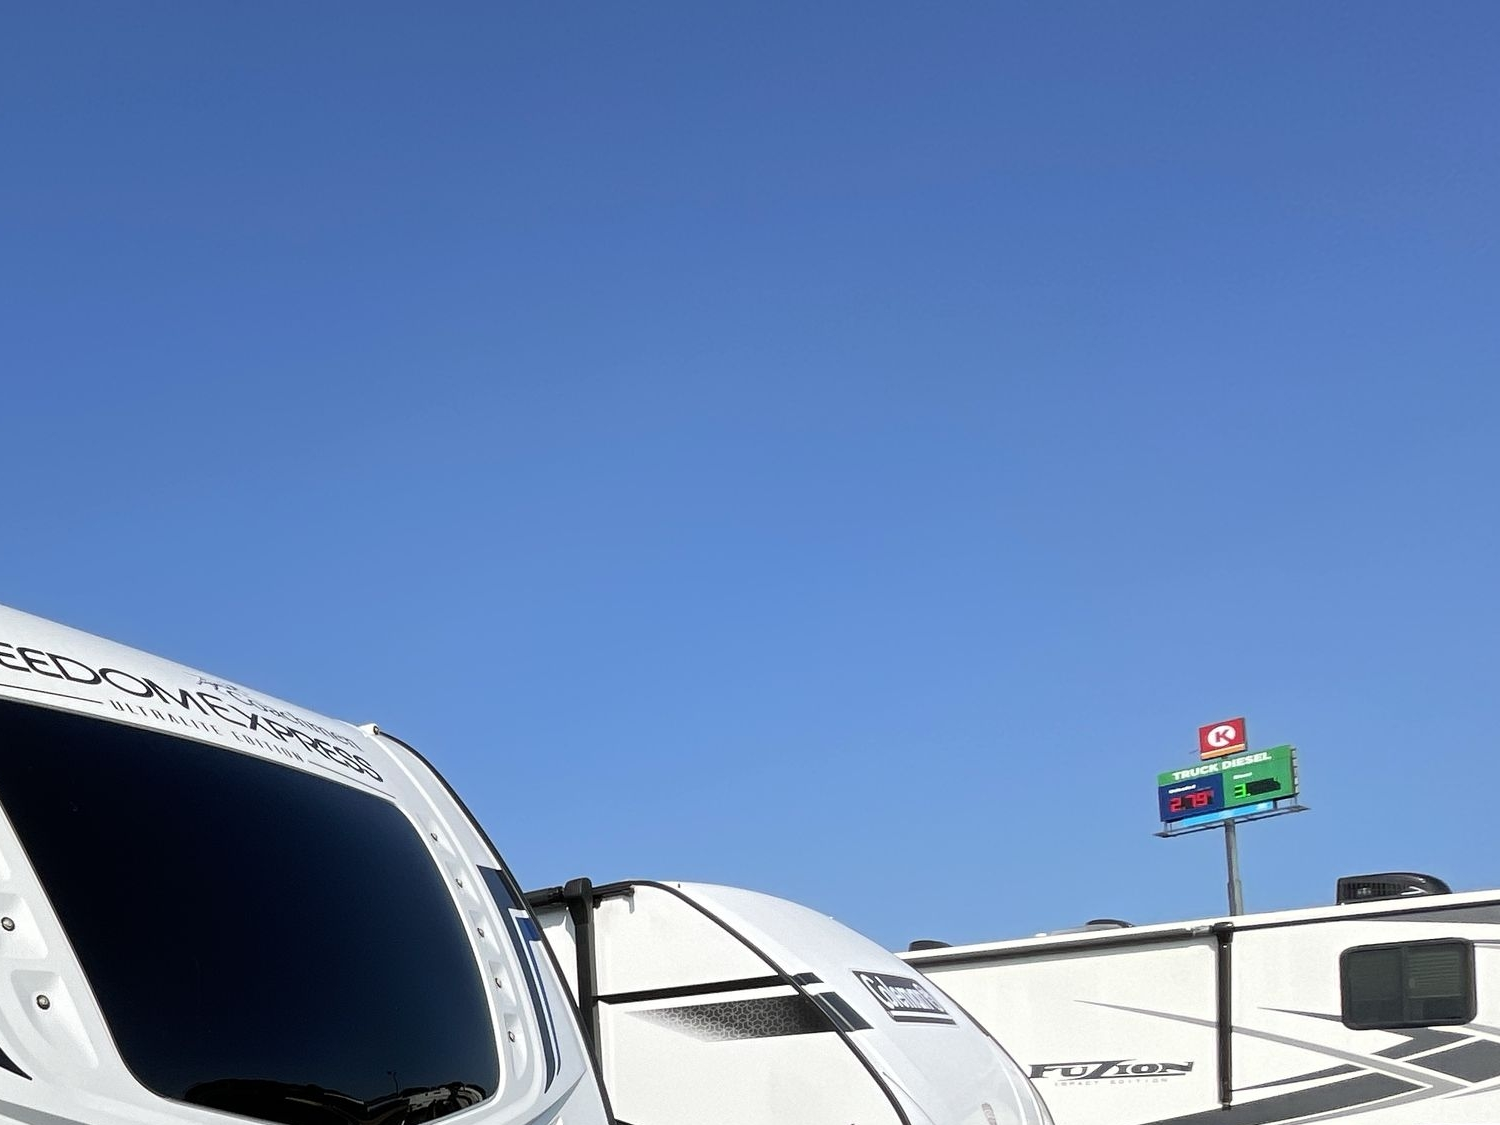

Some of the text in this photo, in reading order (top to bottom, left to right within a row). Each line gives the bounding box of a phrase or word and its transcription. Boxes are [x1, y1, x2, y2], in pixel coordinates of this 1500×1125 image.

[1171, 763, 1219, 781] TRUCK
[1221, 751, 1272, 770] DIESEL
[1110, 1077, 1169, 1085] EDITION
